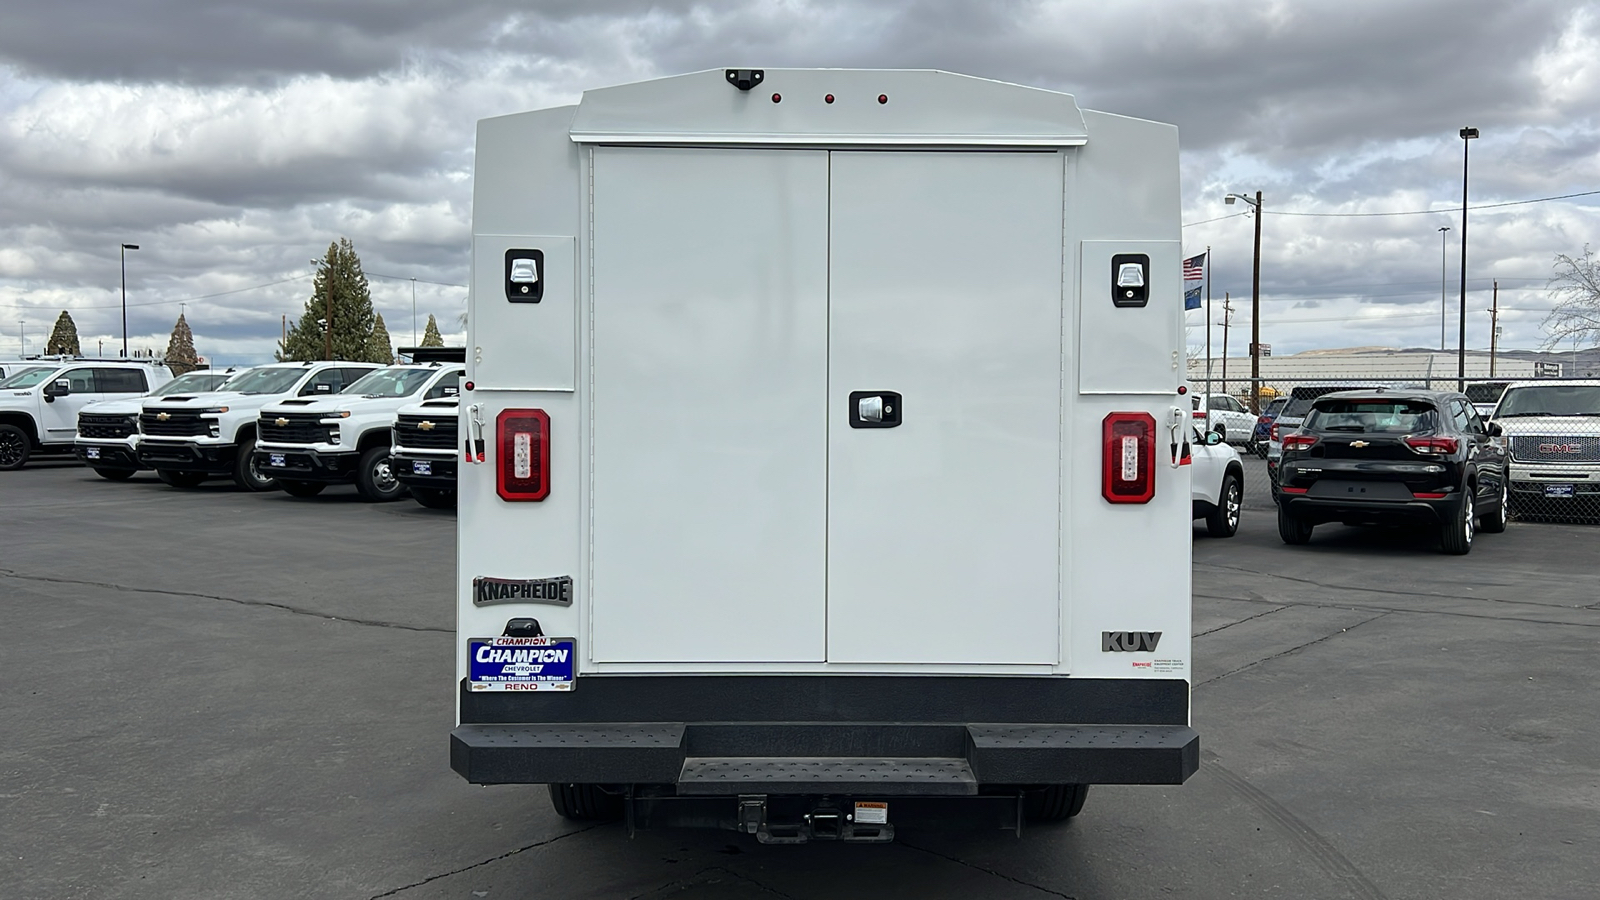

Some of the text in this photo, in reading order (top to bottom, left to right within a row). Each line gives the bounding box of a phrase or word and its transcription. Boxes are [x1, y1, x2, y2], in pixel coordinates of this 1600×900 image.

[1540, 444, 1580, 453] GMC
[477, 580, 569, 603] KNAPHEIDE
[496, 638, 547, 646] CHAMPION
[1102, 631, 1162, 652] KUV
[476, 646, 568, 663] CHAMPION
